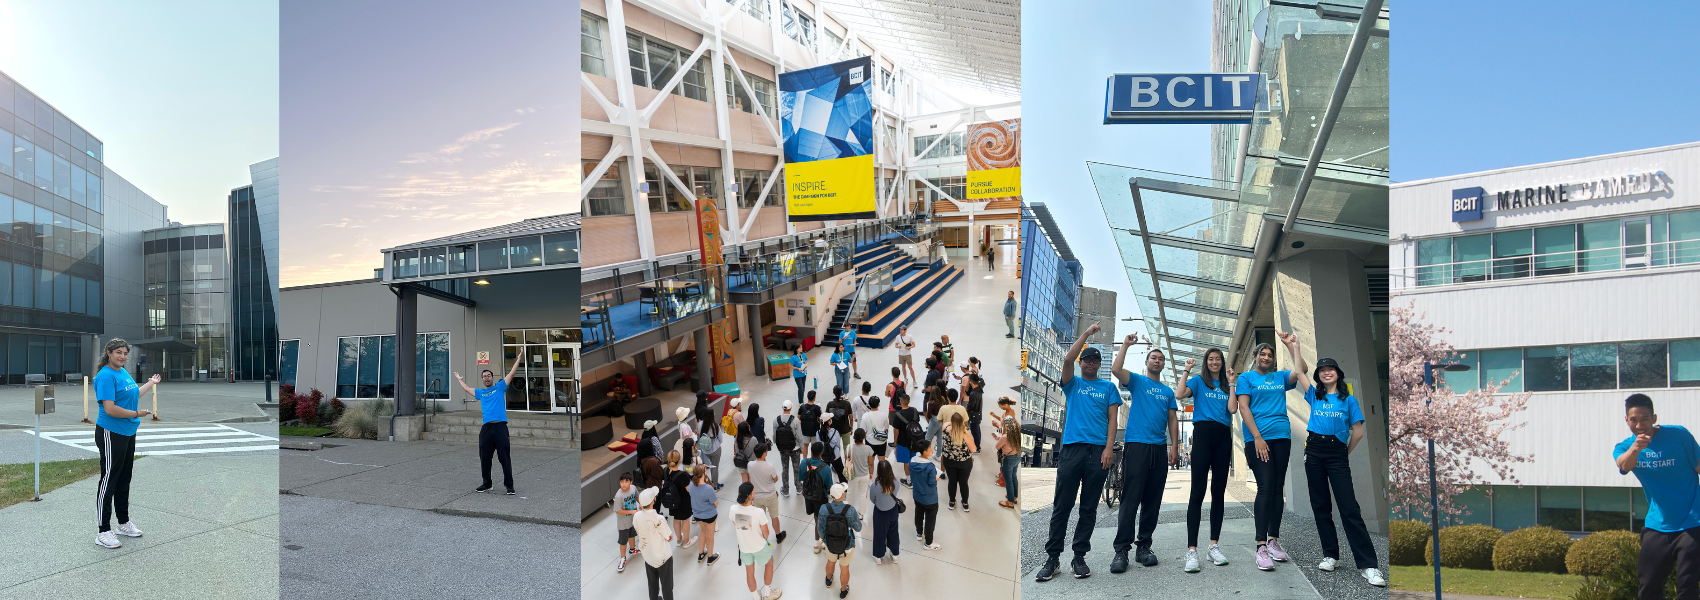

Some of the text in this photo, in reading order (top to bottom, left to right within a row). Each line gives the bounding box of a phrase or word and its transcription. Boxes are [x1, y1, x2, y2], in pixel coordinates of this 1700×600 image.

[850, 71, 862, 80] BCIT
[1130, 76, 1250, 108] BCIT
[792, 180, 828, 192] INSPIRE.
[970, 186, 1016, 194] COLLABORATION
[1498, 170, 1665, 211] MARINE CAMPUS
[1454, 196, 1478, 212] BCIT
[1653, 459, 1675, 468] START
